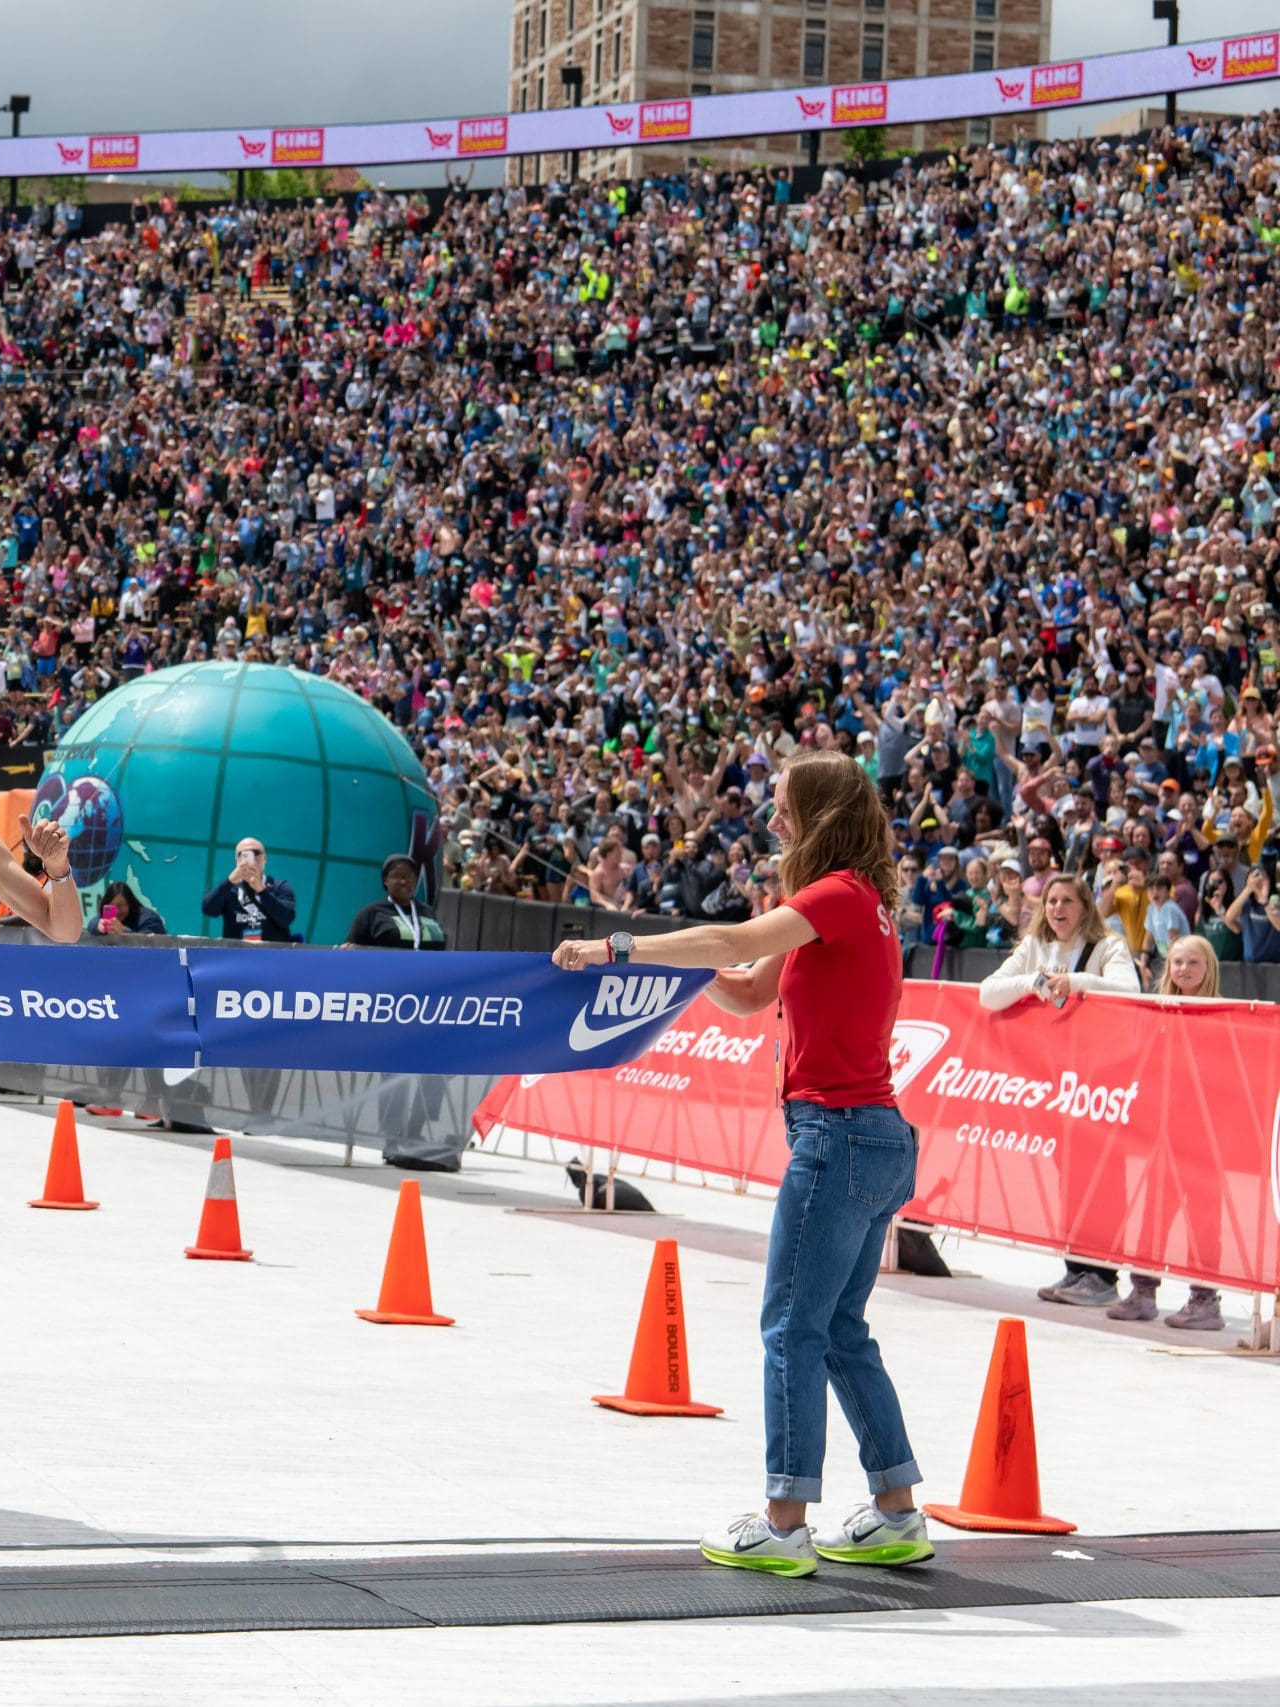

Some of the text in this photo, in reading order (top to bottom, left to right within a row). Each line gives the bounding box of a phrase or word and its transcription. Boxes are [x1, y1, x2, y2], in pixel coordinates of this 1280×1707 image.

[1227, 38, 1275, 60] KING
[1035, 65, 1079, 85] KING
[836, 86, 883, 105] KING
[643, 104, 688, 121] KING
[277, 132, 320, 148] KING
[461, 119, 504, 137] KING
[93, 137, 136, 154] KING
[21, 989, 120, 1021] Roost
[216, 989, 524, 1028] BOLDERBOULDER
[592, 975, 683, 1017] RUN
[649, 1025, 766, 1065] ers Roost
[615, 1066, 692, 1092] COLORADO
[926, 1056, 1053, 1109] Runners
[956, 1122, 1057, 1159] COLORADO
[666, 1323, 680, 1393] BOULDER
